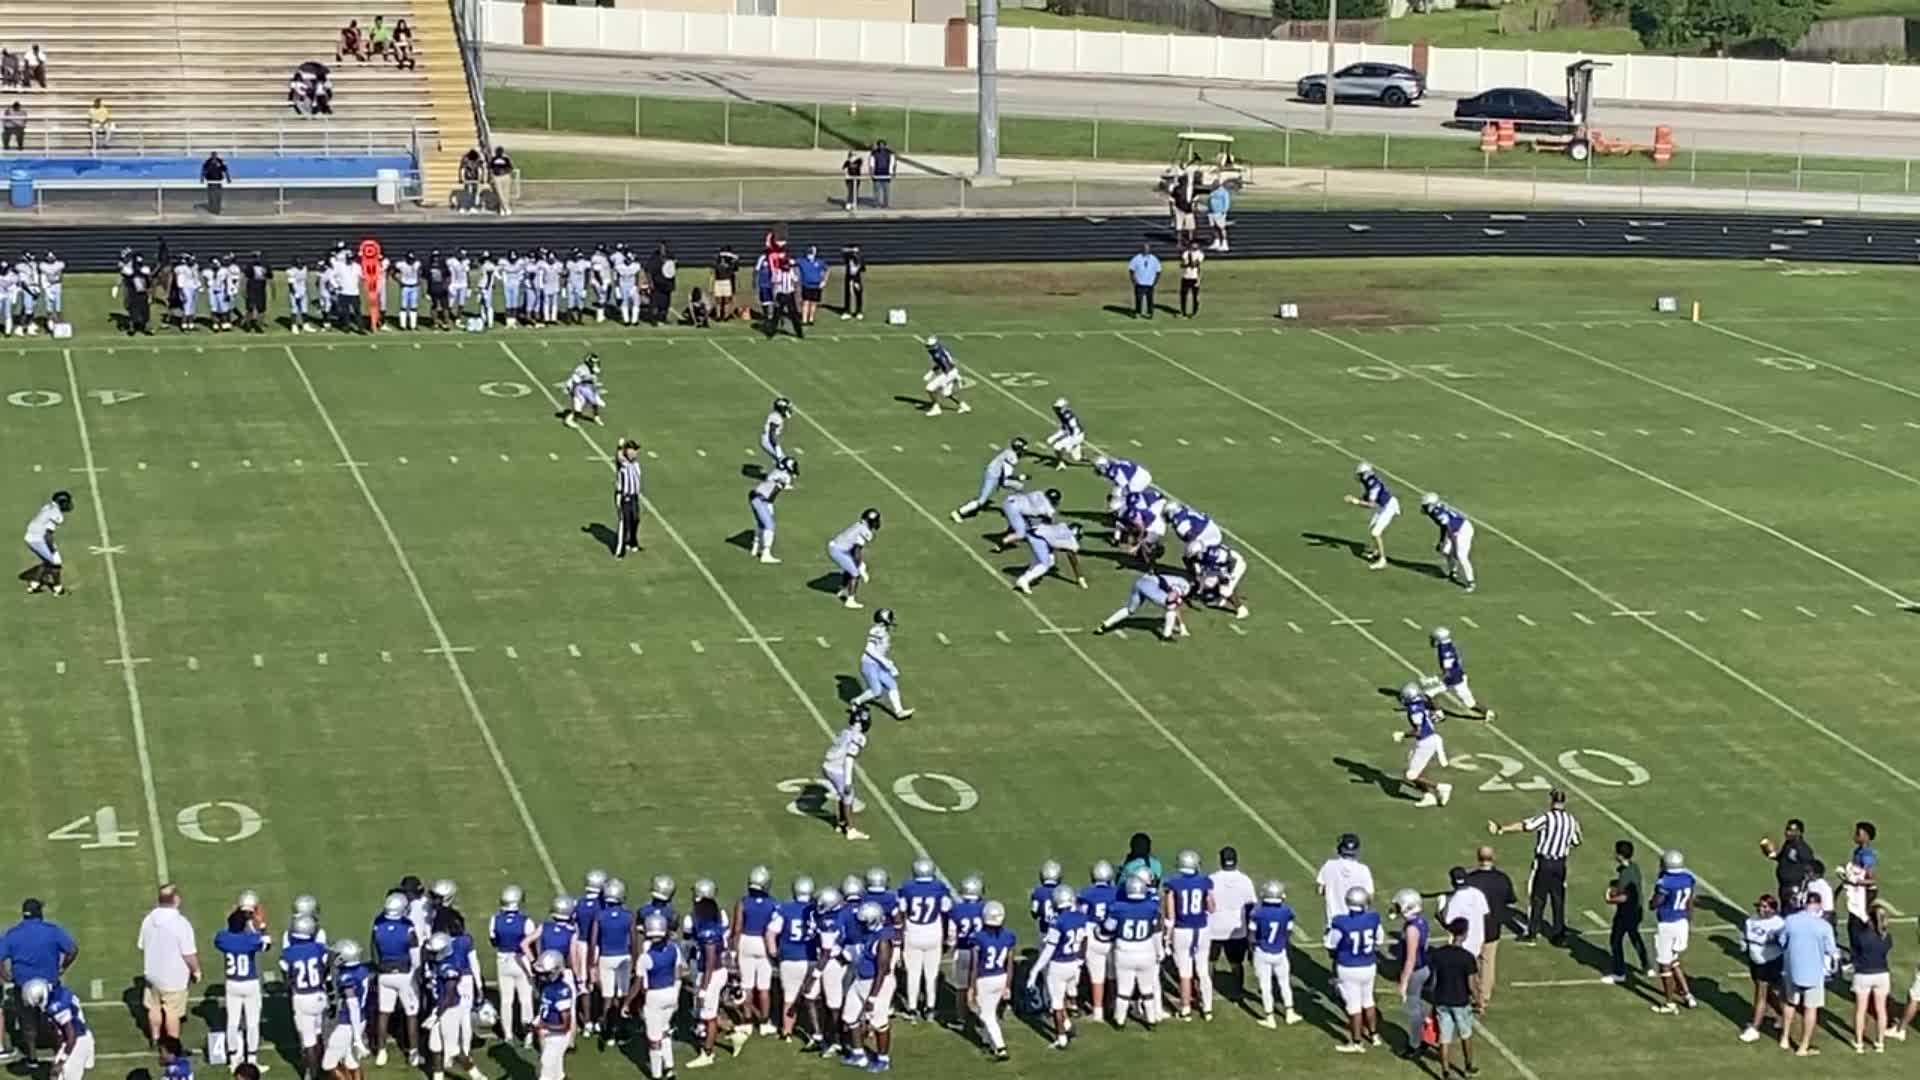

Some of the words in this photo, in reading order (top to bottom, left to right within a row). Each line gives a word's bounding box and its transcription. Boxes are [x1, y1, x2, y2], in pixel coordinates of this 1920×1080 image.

[1449, 749, 1650, 791] 20
[48, 801, 263, 849] 40
[910, 896, 935, 923] 57
[1181, 889, 1202, 915] 18
[1123, 919, 1149, 940] 60
[1267, 922, 1279, 944] 7
[1349, 929, 1375, 956] 75
[225, 952, 250, 977] 30
[984, 946, 1008, 970] 34
[293, 957, 320, 988] 26
